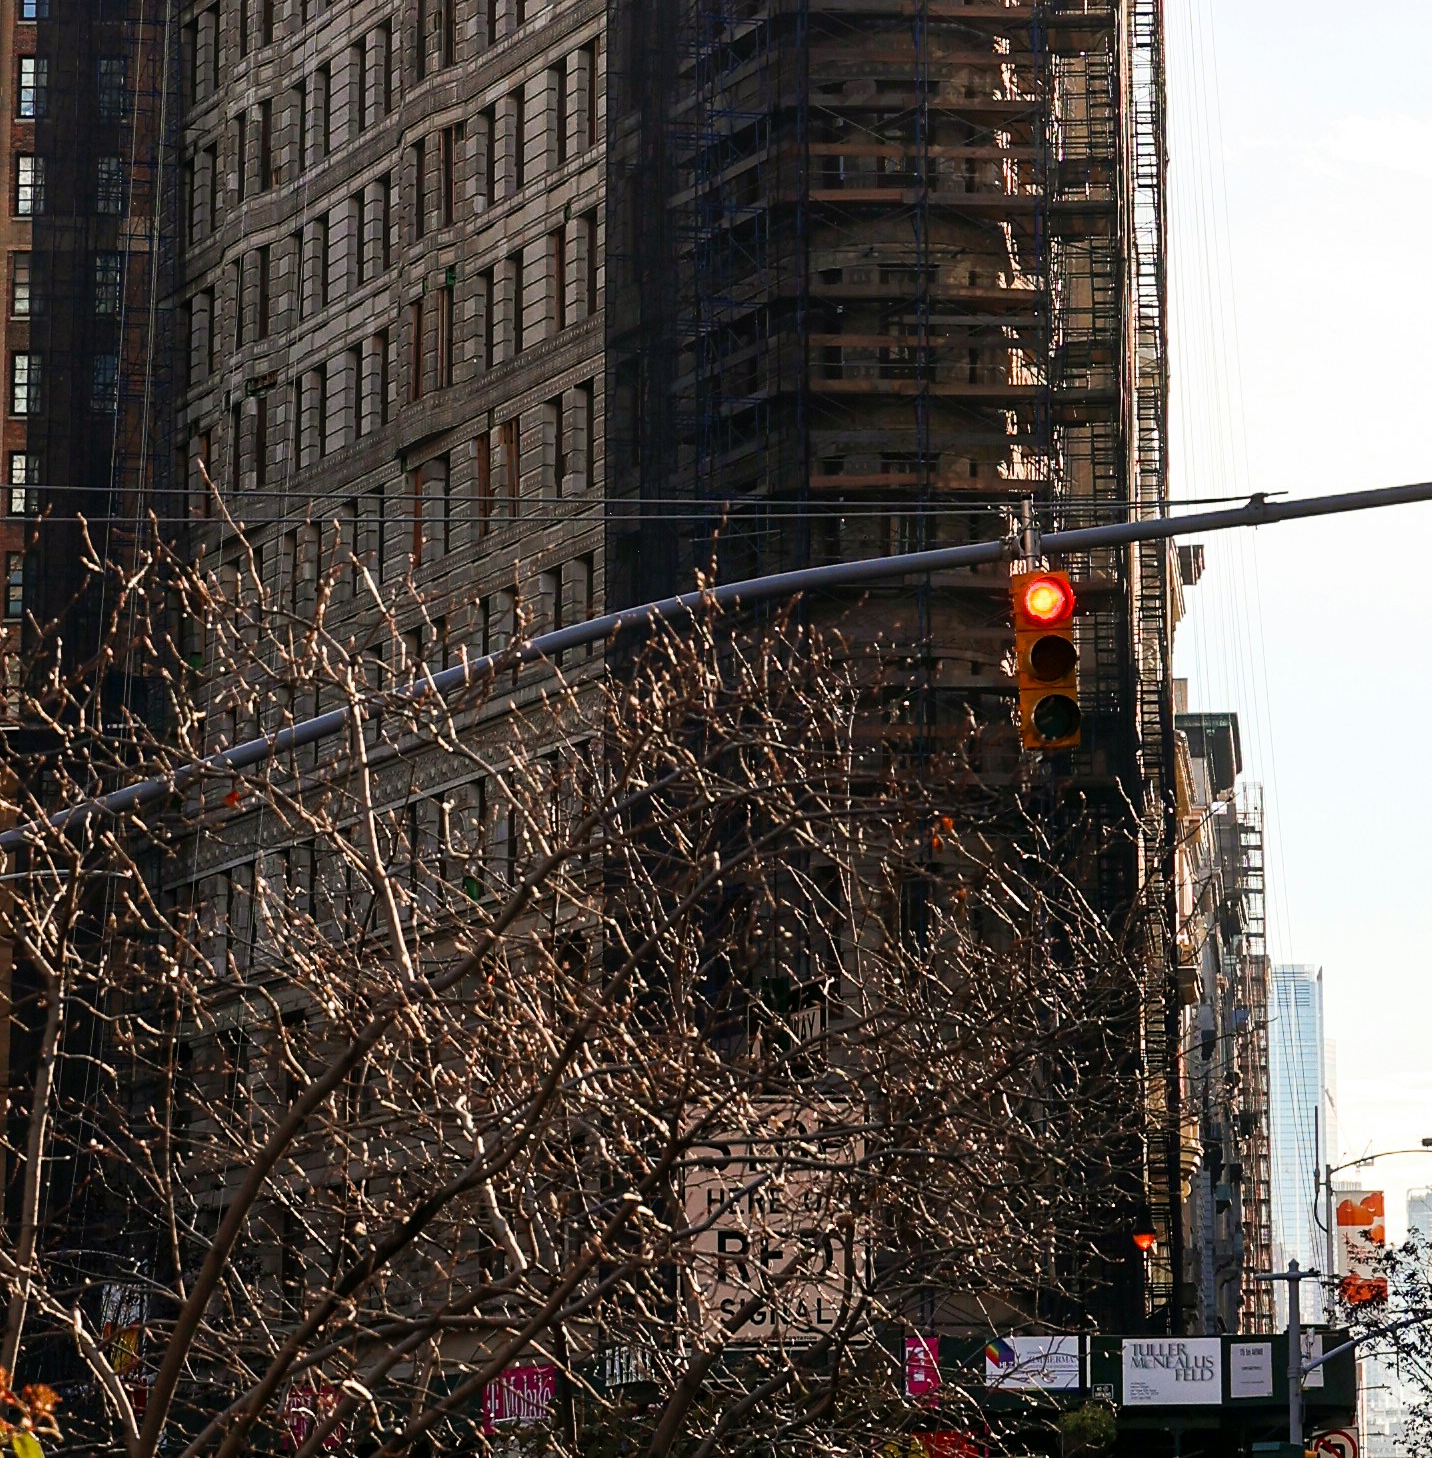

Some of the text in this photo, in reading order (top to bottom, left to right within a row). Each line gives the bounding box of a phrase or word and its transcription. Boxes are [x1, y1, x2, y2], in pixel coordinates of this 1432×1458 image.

[717, 1230, 833, 1283] RED
[720, 1297, 833, 1326] SGNAL
[1130, 1343, 1188, 1356] TULLER
[1175, 1368, 1214, 1382] FELD
